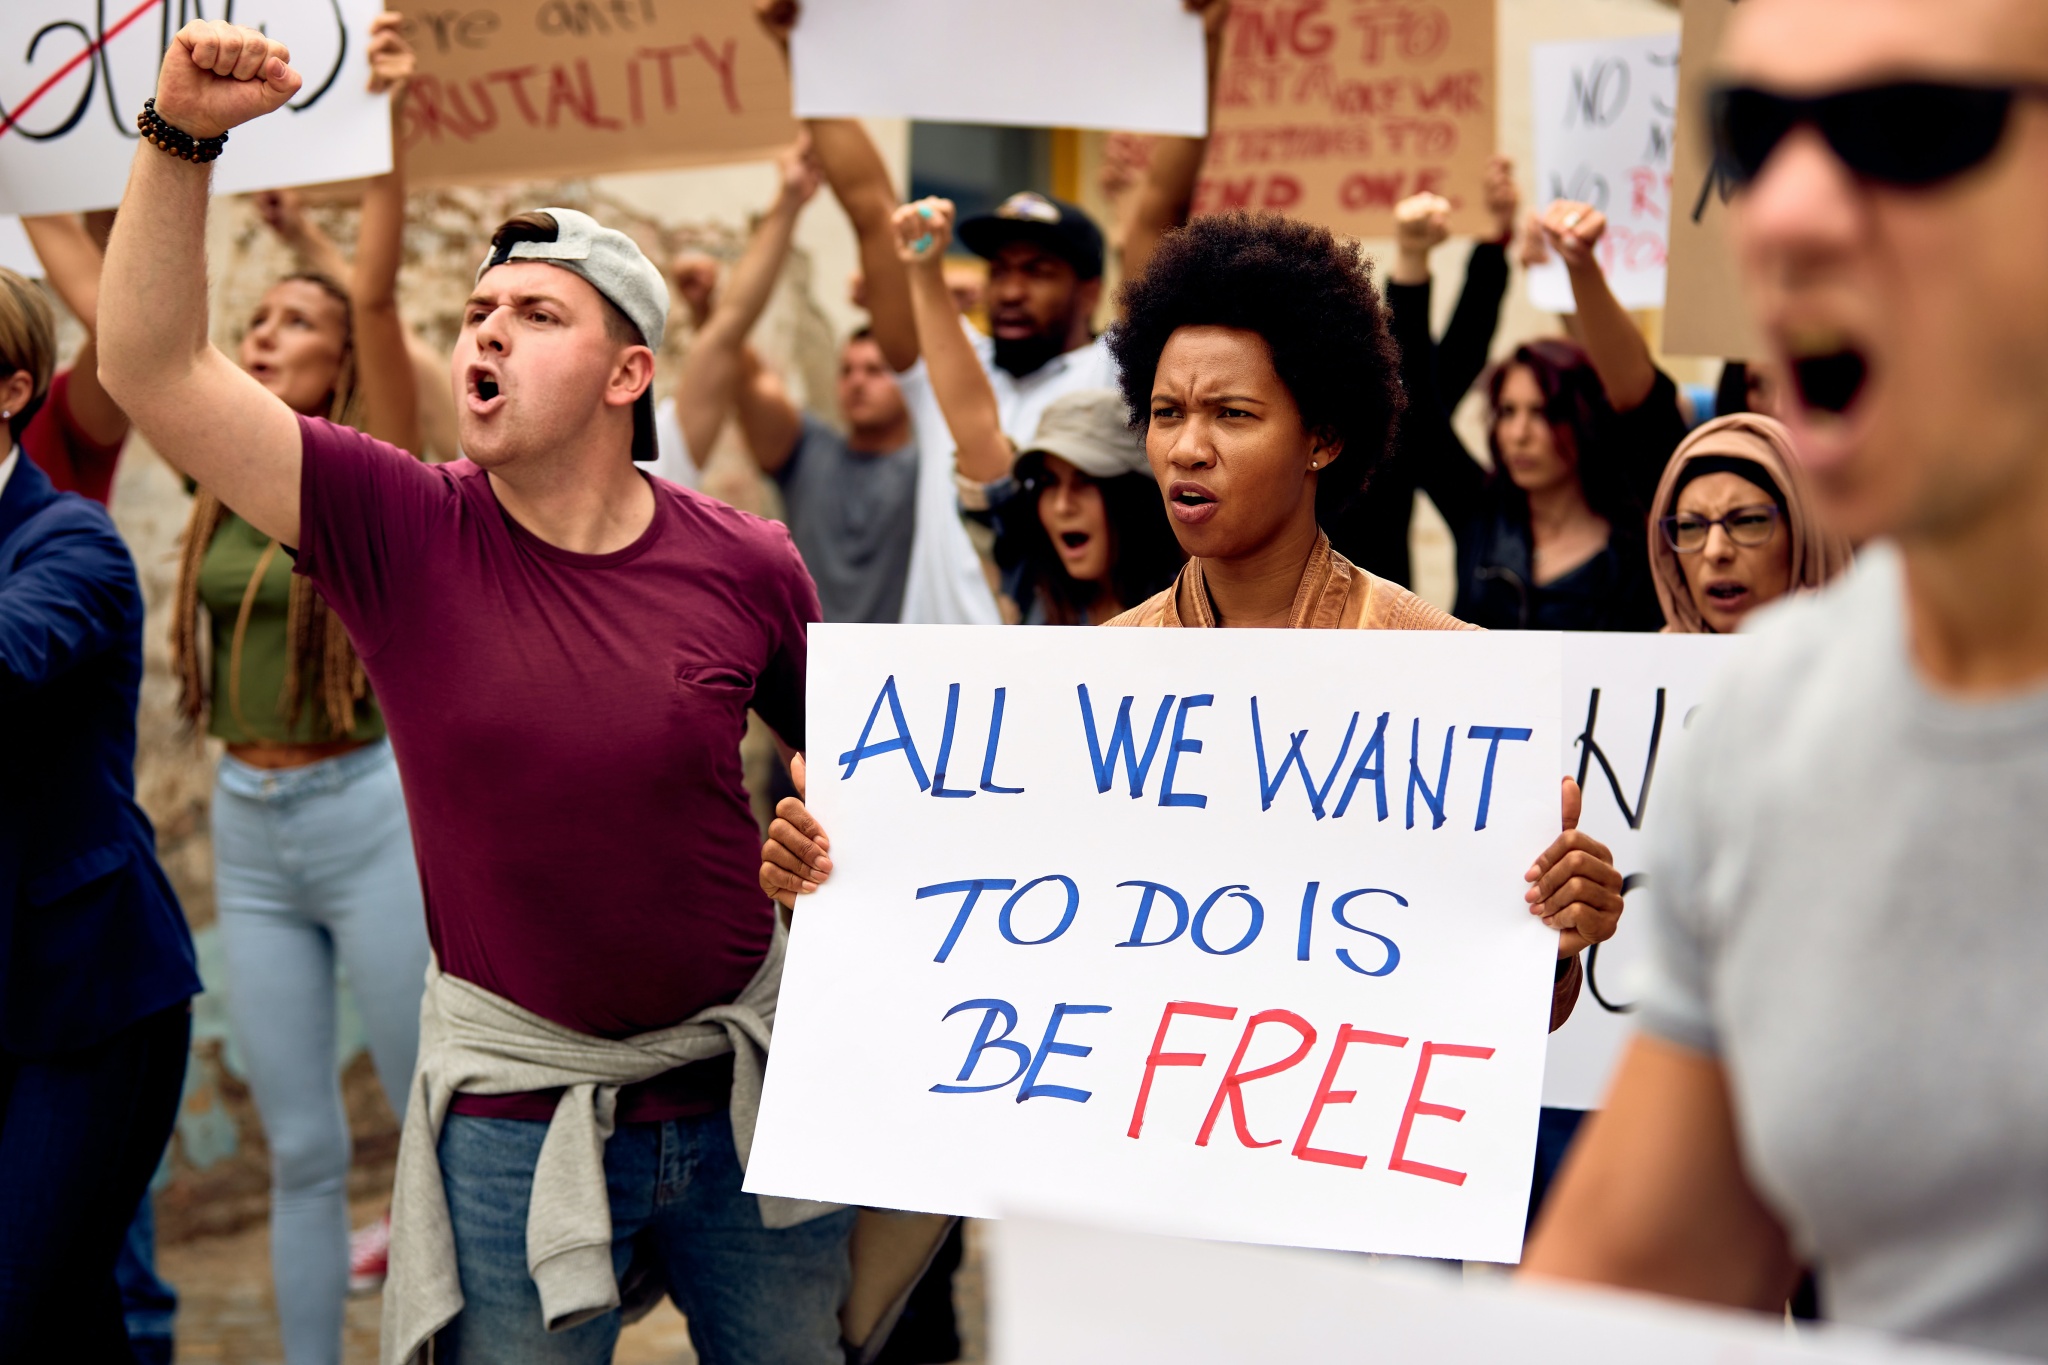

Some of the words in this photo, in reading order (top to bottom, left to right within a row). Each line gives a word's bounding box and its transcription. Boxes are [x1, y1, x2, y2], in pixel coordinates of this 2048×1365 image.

[1352, 5, 1452, 65] TO
[839, 675, 1024, 799] ALL
[1077, 683, 1214, 808] WE
[1250, 695, 1532, 831] WANT
[915, 875, 1080, 963] TO
[1115, 880, 1265, 956] DO
[1297, 881, 1409, 977] IS
[928, 999, 1113, 1104] BE
[1127, 1000, 1496, 1187] FREE
